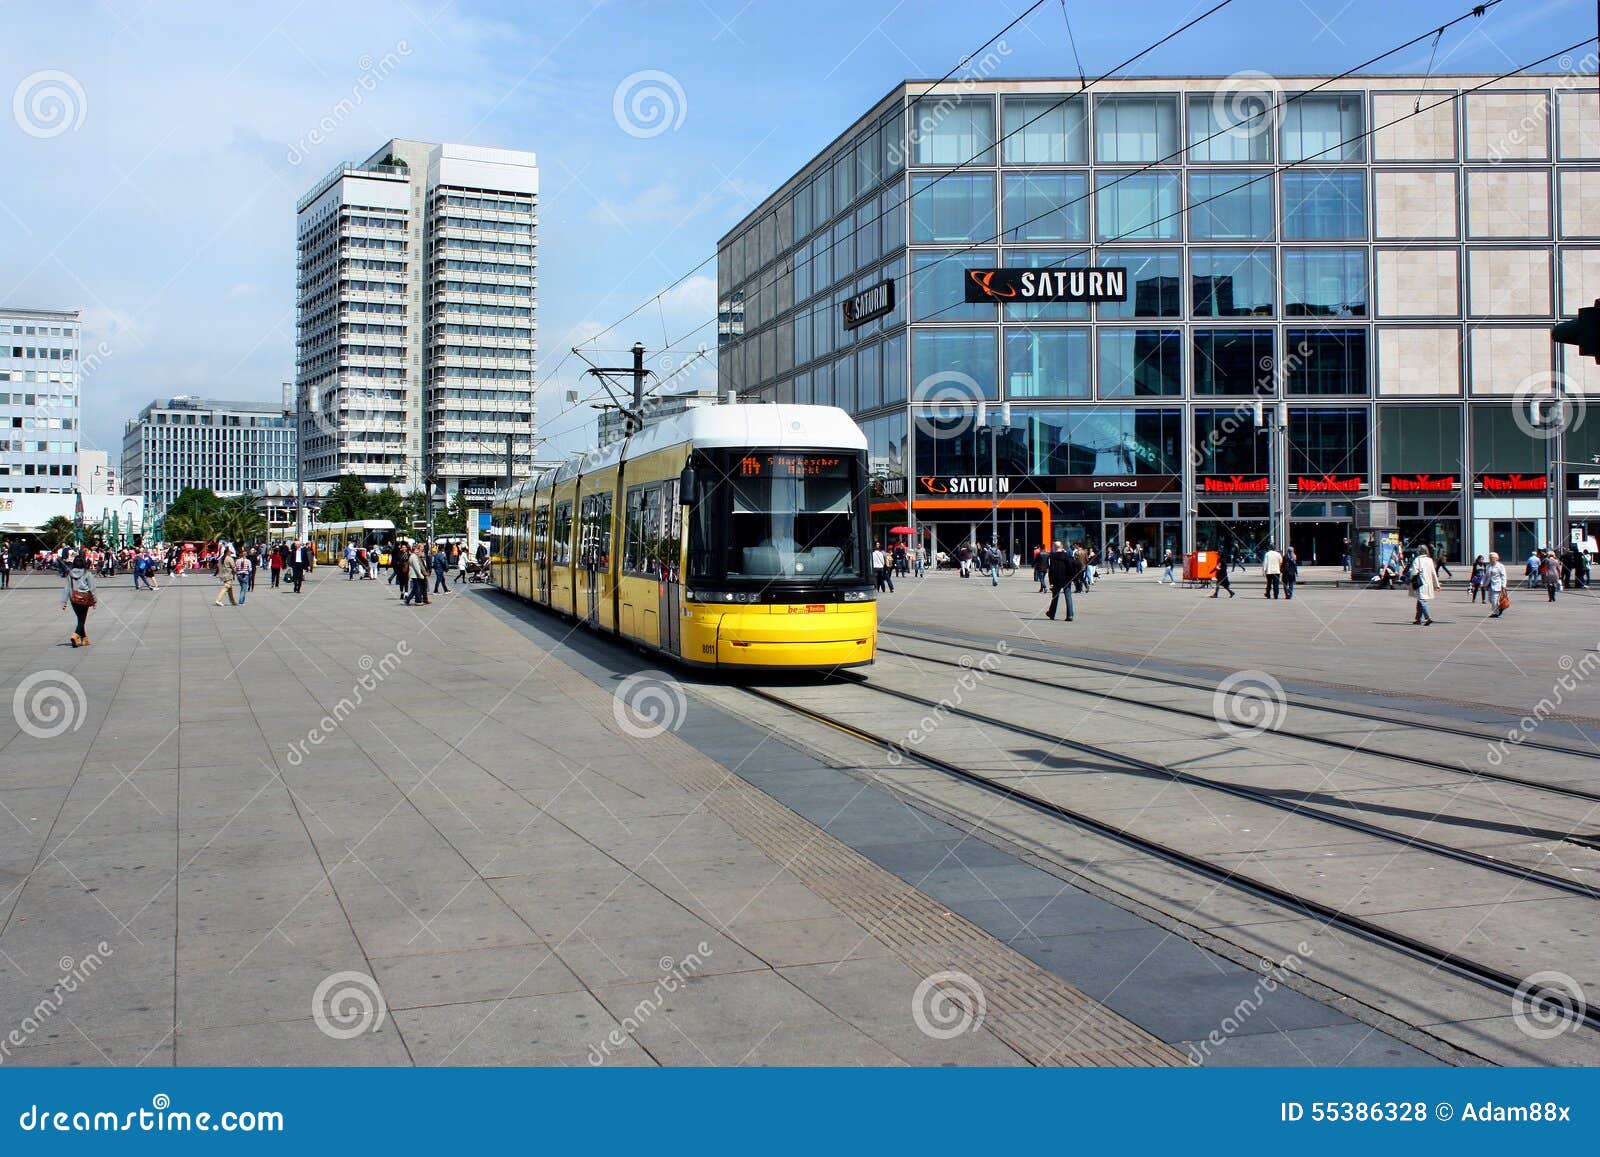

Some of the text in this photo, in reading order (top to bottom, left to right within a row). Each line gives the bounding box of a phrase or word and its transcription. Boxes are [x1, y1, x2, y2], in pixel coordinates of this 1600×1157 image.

[1021, 271, 1124, 297] SATURN
[855, 284, 888, 320] SATURN
[742, 456, 840, 475] M4 S Hackescher
[1093, 480, 1137, 489] promod
[702, 644, 715, 655] 8011
